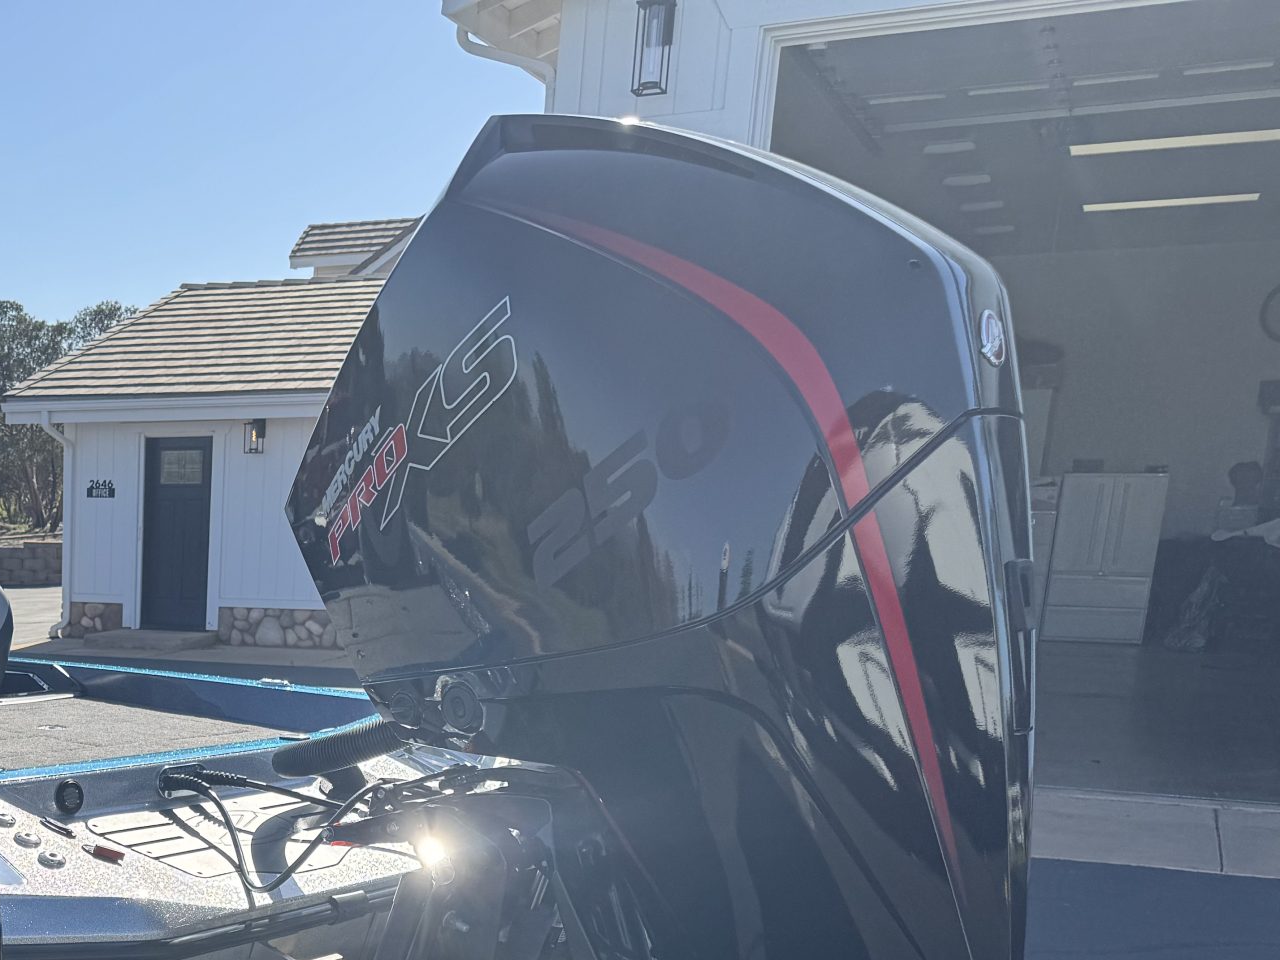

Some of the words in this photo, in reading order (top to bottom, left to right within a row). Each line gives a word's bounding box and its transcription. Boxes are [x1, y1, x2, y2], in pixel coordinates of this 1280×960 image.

[321, 405, 381, 515] MERCURY
[328, 424, 407, 566] PRO
[527, 399, 732, 592] 250
